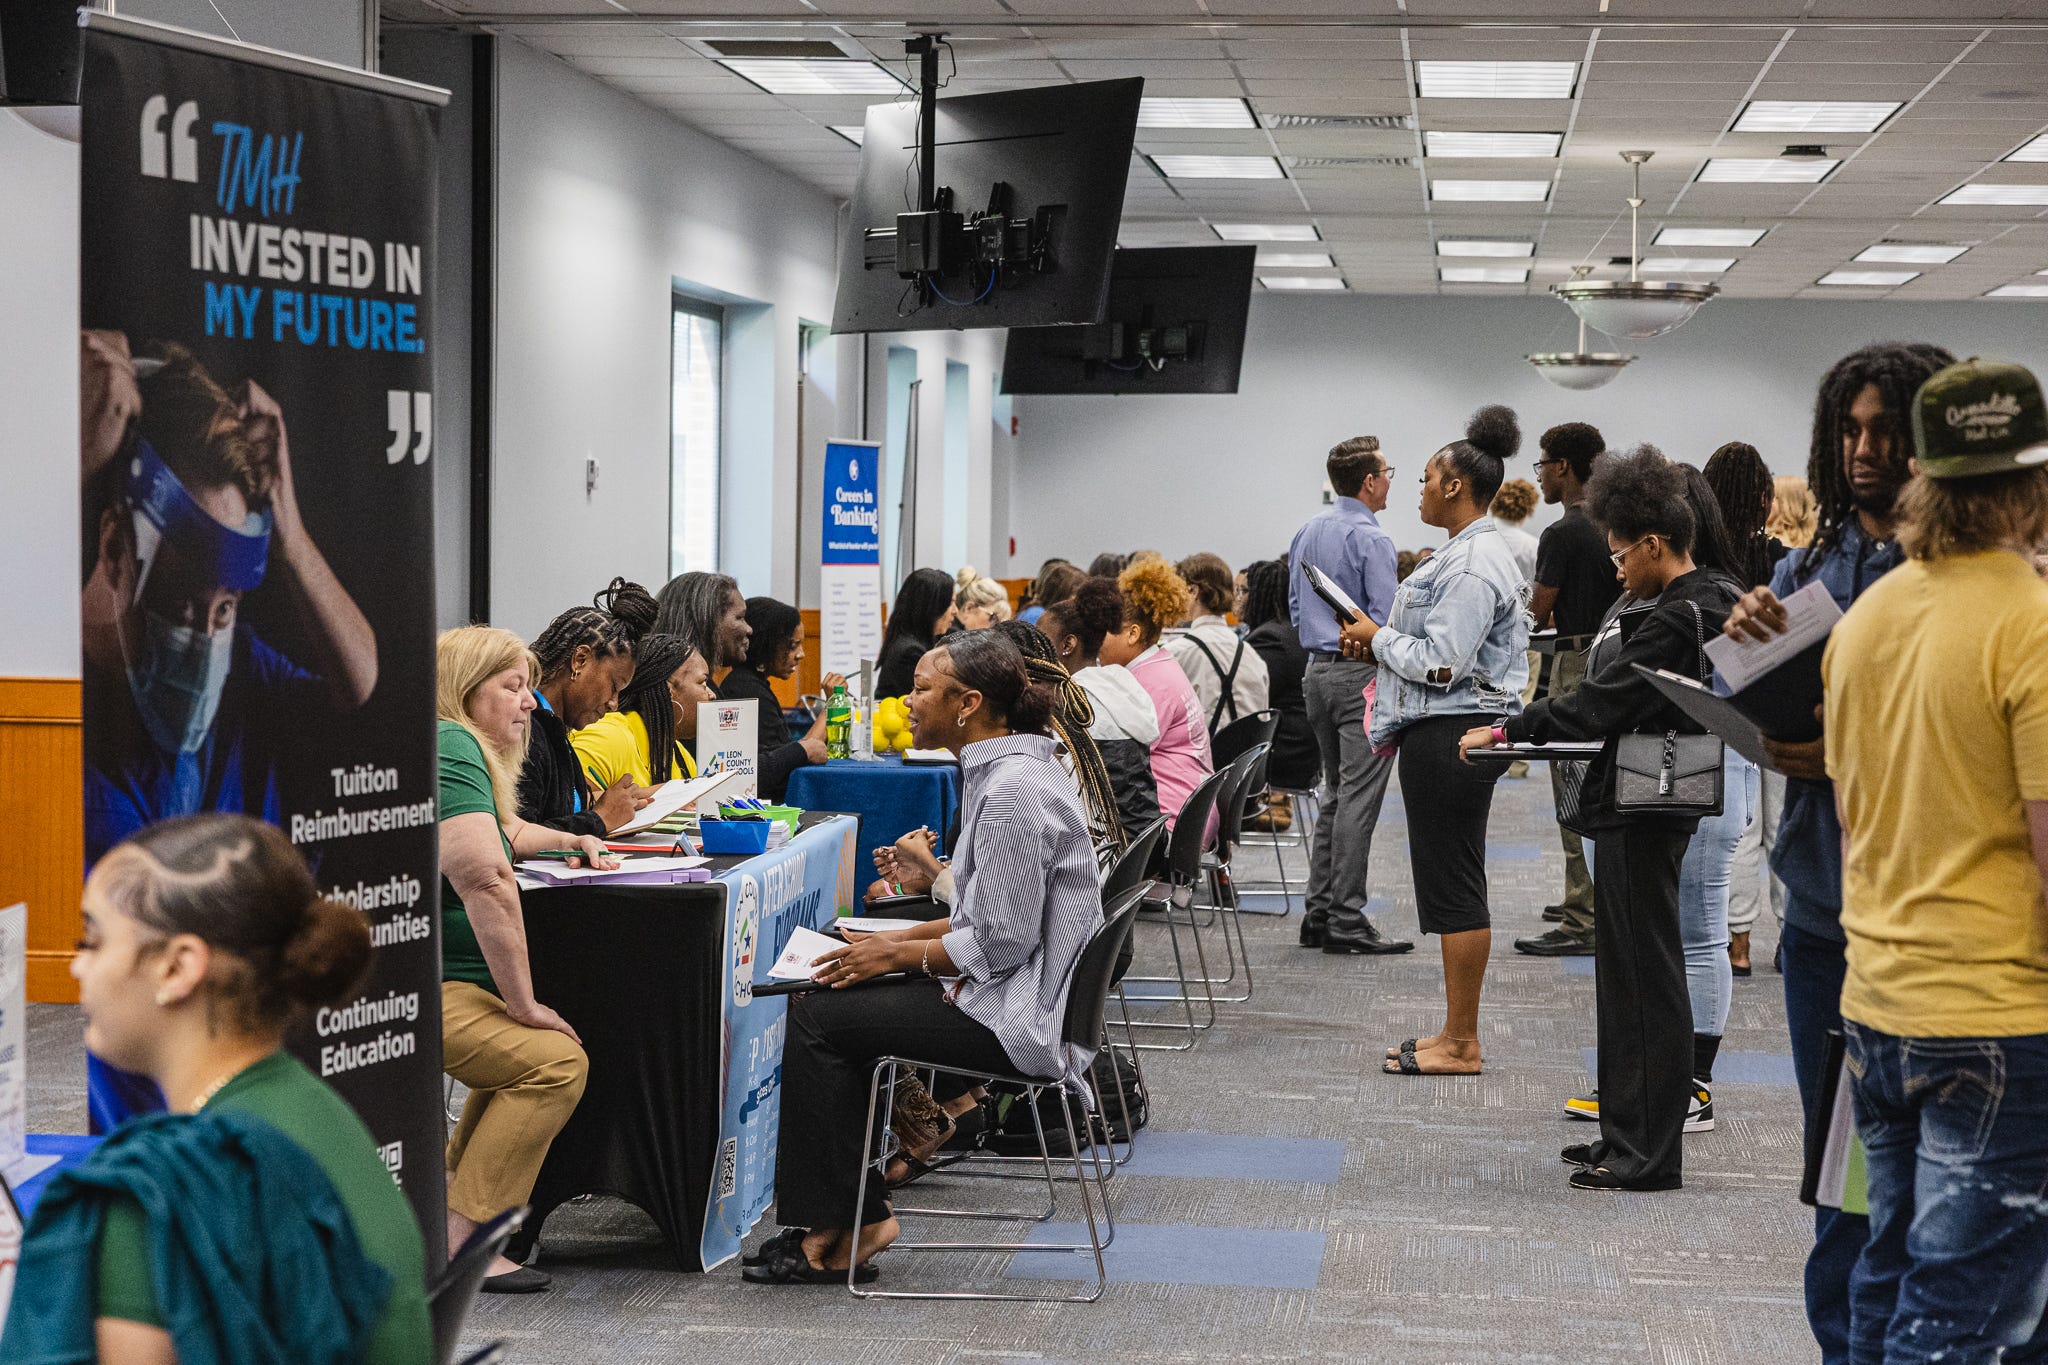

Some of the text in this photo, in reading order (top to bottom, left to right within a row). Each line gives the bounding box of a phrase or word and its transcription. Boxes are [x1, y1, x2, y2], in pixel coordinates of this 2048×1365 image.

[212, 121, 303, 217] TMH
[190, 213, 422, 295] INVESTED IN
[204, 281, 425, 353] MY FUTURE.
[835, 486, 864, 504] Careers
[830, 504, 878, 535] Banking
[726, 750, 742, 759] LEON
[726, 758, 751, 768] COUNTY
[331, 763, 398, 797] Tuition
[291, 797, 435, 845] Reimbursement
[317, 873, 421, 912] holarship
[762, 863, 784, 919] AFTER
[784, 849, 807, 902] SCHOOL
[316, 990, 419, 1037] Continuing
[321, 1030, 415, 1077] Education
